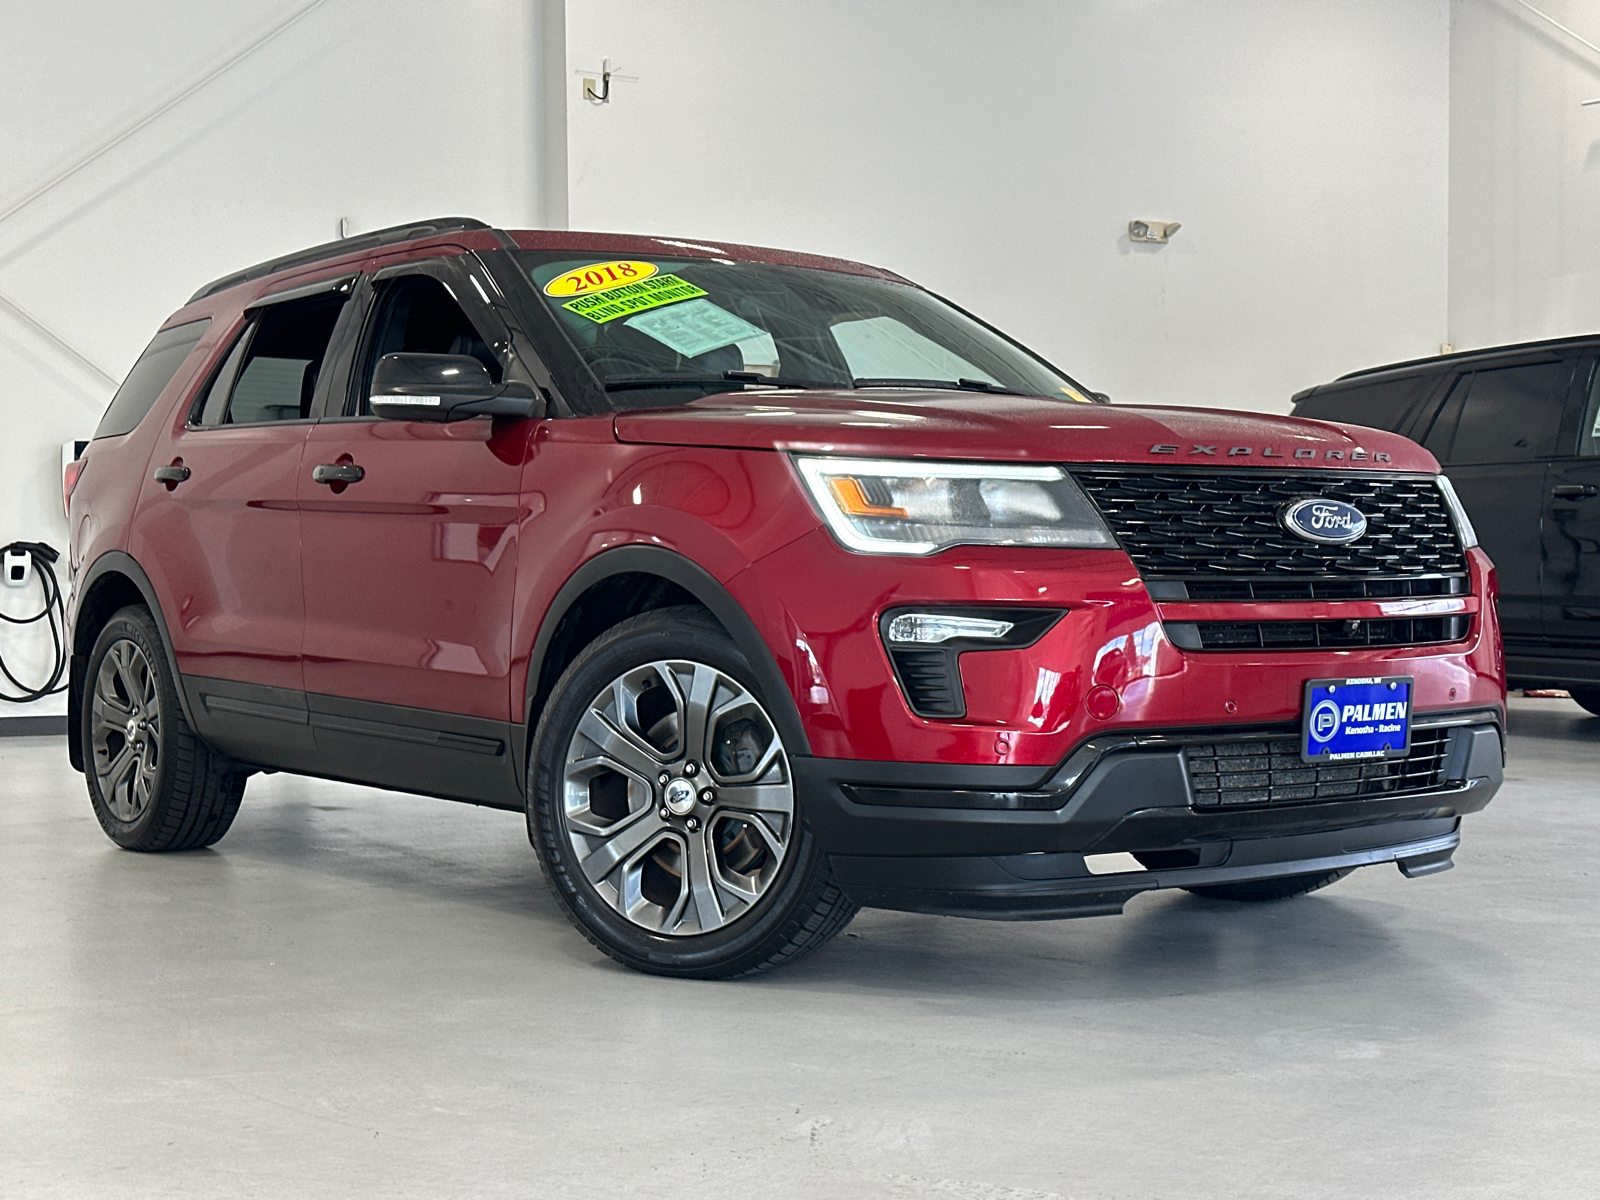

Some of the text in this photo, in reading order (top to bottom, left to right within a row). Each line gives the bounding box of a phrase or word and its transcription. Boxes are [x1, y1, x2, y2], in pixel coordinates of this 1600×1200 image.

[566, 263, 638, 292] 2018
[569, 276, 681, 312] PUSH BUTTON START
[586, 285, 699, 321] BLIND SPOT MONITOR
[1148, 443, 1393, 463] EXPLORER
[1310, 505, 1355, 530] Ford
[126, 622, 157, 675] MICHELIN
[1341, 701, 1407, 723] PALMEN
[1345, 723, 1401, 735] Kenosha Racine
[1329, 750, 1385, 760] PALMEN CADILLAC
[537, 771, 577, 893] MICHELIN
